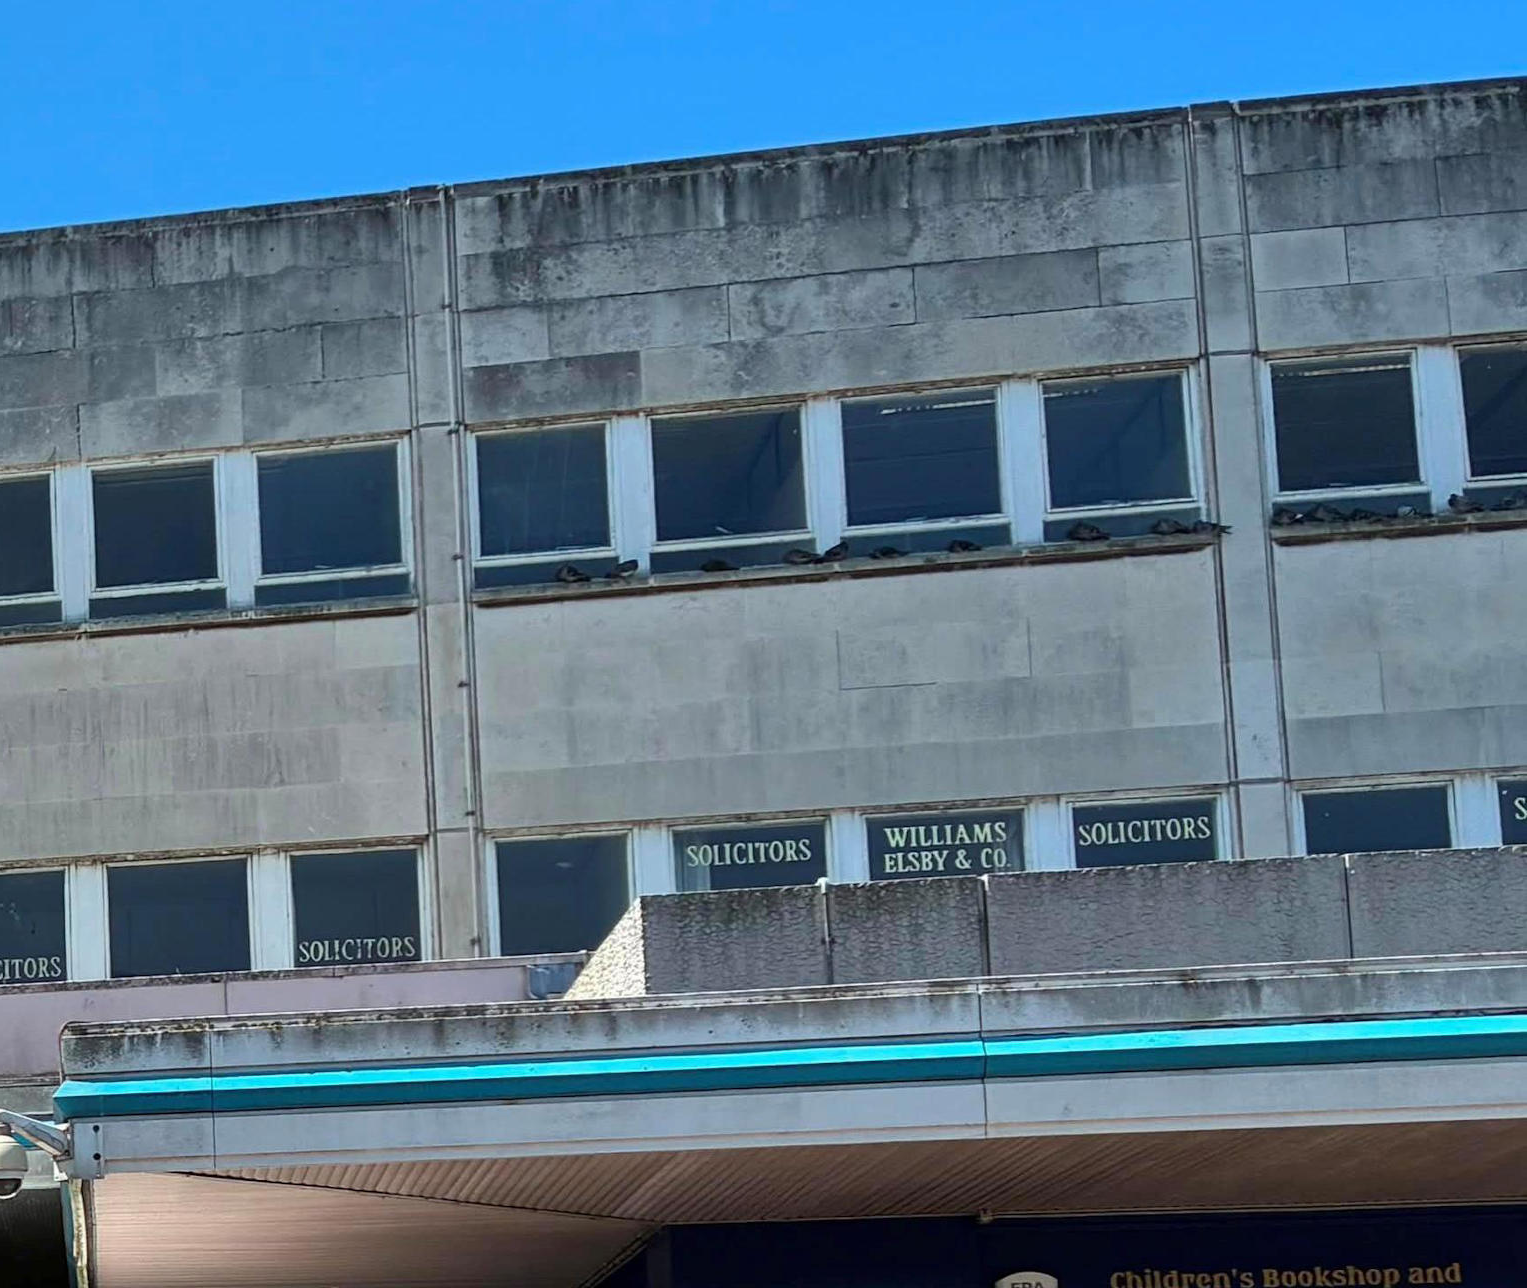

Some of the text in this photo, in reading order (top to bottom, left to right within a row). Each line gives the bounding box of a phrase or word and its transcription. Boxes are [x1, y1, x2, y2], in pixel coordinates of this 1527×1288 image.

[883, 822, 1006, 848] WILLIAMS
[1079, 817, 1211, 846] SOLICITORS
[687, 839, 812, 867] SOLICITORS
[884, 850, 948, 874] ELSBY
[955, 850, 972, 870] &
[298, 936, 416, 963] SOLICITORS
[1408, 1262, 1462, 1284] and
